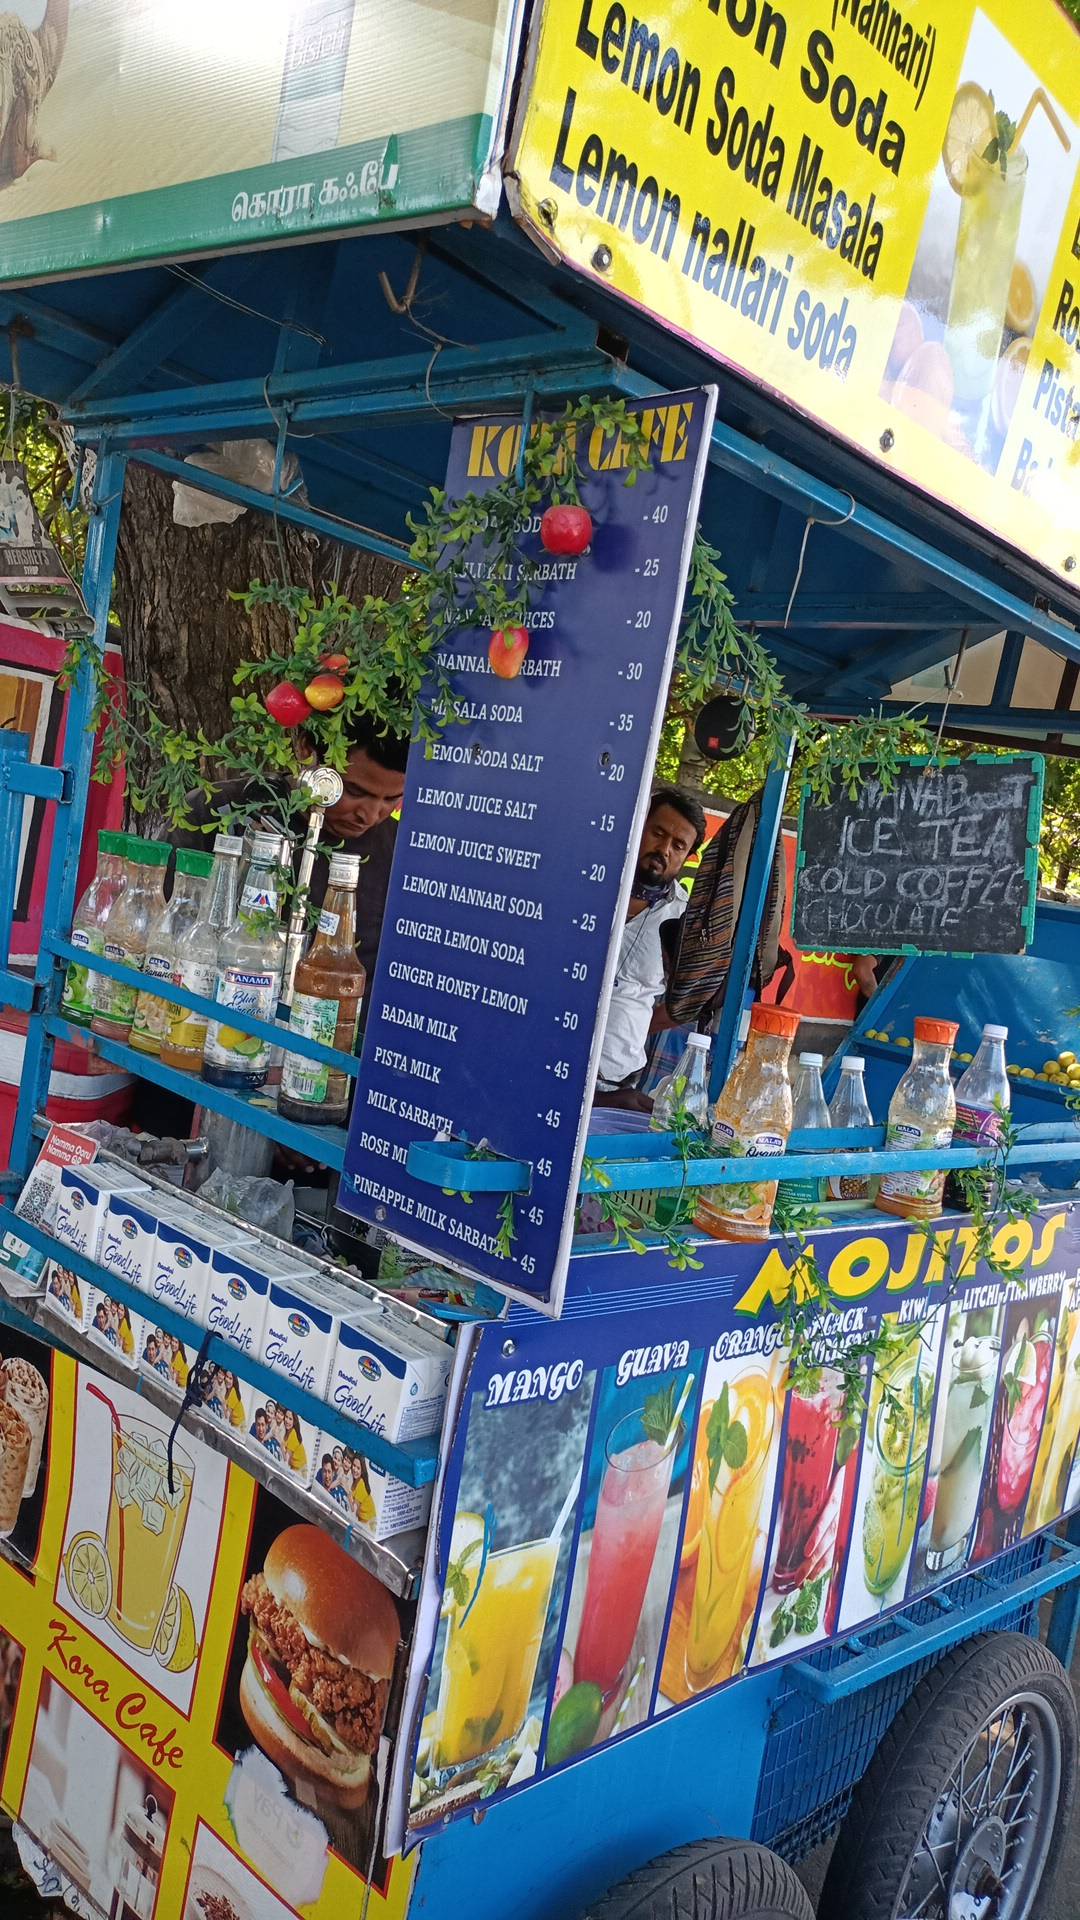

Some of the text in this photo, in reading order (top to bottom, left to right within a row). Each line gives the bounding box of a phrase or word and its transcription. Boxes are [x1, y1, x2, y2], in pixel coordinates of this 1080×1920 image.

[800, 29, 906, 178] Soda
[575, 0, 885, 282] Lemon Soda Masala
[549, 86, 858, 382] Lemon nallari soda
[489, 704, 523, 723] SODA
[474, 748, 508, 769] SODA
[510, 752, 544, 773] SALT
[416, 787, 464, 809] LEMON
[465, 794, 503, 815] JUICE
[504, 799, 538, 820] SALT
[409, 831, 456, 854] LEMON
[456, 839, 495, 861] JUICE
[495, 846, 542, 870] SWEET
[838, 812, 1018, 861] ICE TEA
[402, 874, 448, 899] LEMON
[449, 884, 507, 912] NANNARI
[508, 897, 543, 921] SODA
[798, 864, 888, 898] COLD
[396, 918, 442, 944] GINGER
[443, 929, 490, 955] LEMON
[490, 941, 525, 966] SODA
[232, 990, 258, 1006] Blue
[388, 961, 434, 988] GINGER
[435, 974, 481, 1001] HONEY
[481, 986, 529, 1015] LEMON
[381, 1003, 425, 1032] BADAM
[426, 1017, 459, 1043] MILK
[374, 1046, 408, 1072] PISTA
[409, 1058, 442, 1084] MILK
[366, 1089, 398, 1114] MILK
[398, 1101, 453, 1133] SARBATH
[359, 1131, 391, 1158] ROSE
[353, 1173, 415, 1217] PINEAPPLE
[415, 1203, 448, 1232] MILK
[733, 1212, 1067, 1320] MOJITOS
[961, 1283, 1001, 1311] LITCHI
[484, 1358, 585, 1408] MANGO
[614, 1338, 691, 1388] GUAVA
[47, 1618, 185, 1770] Kora Cafe
